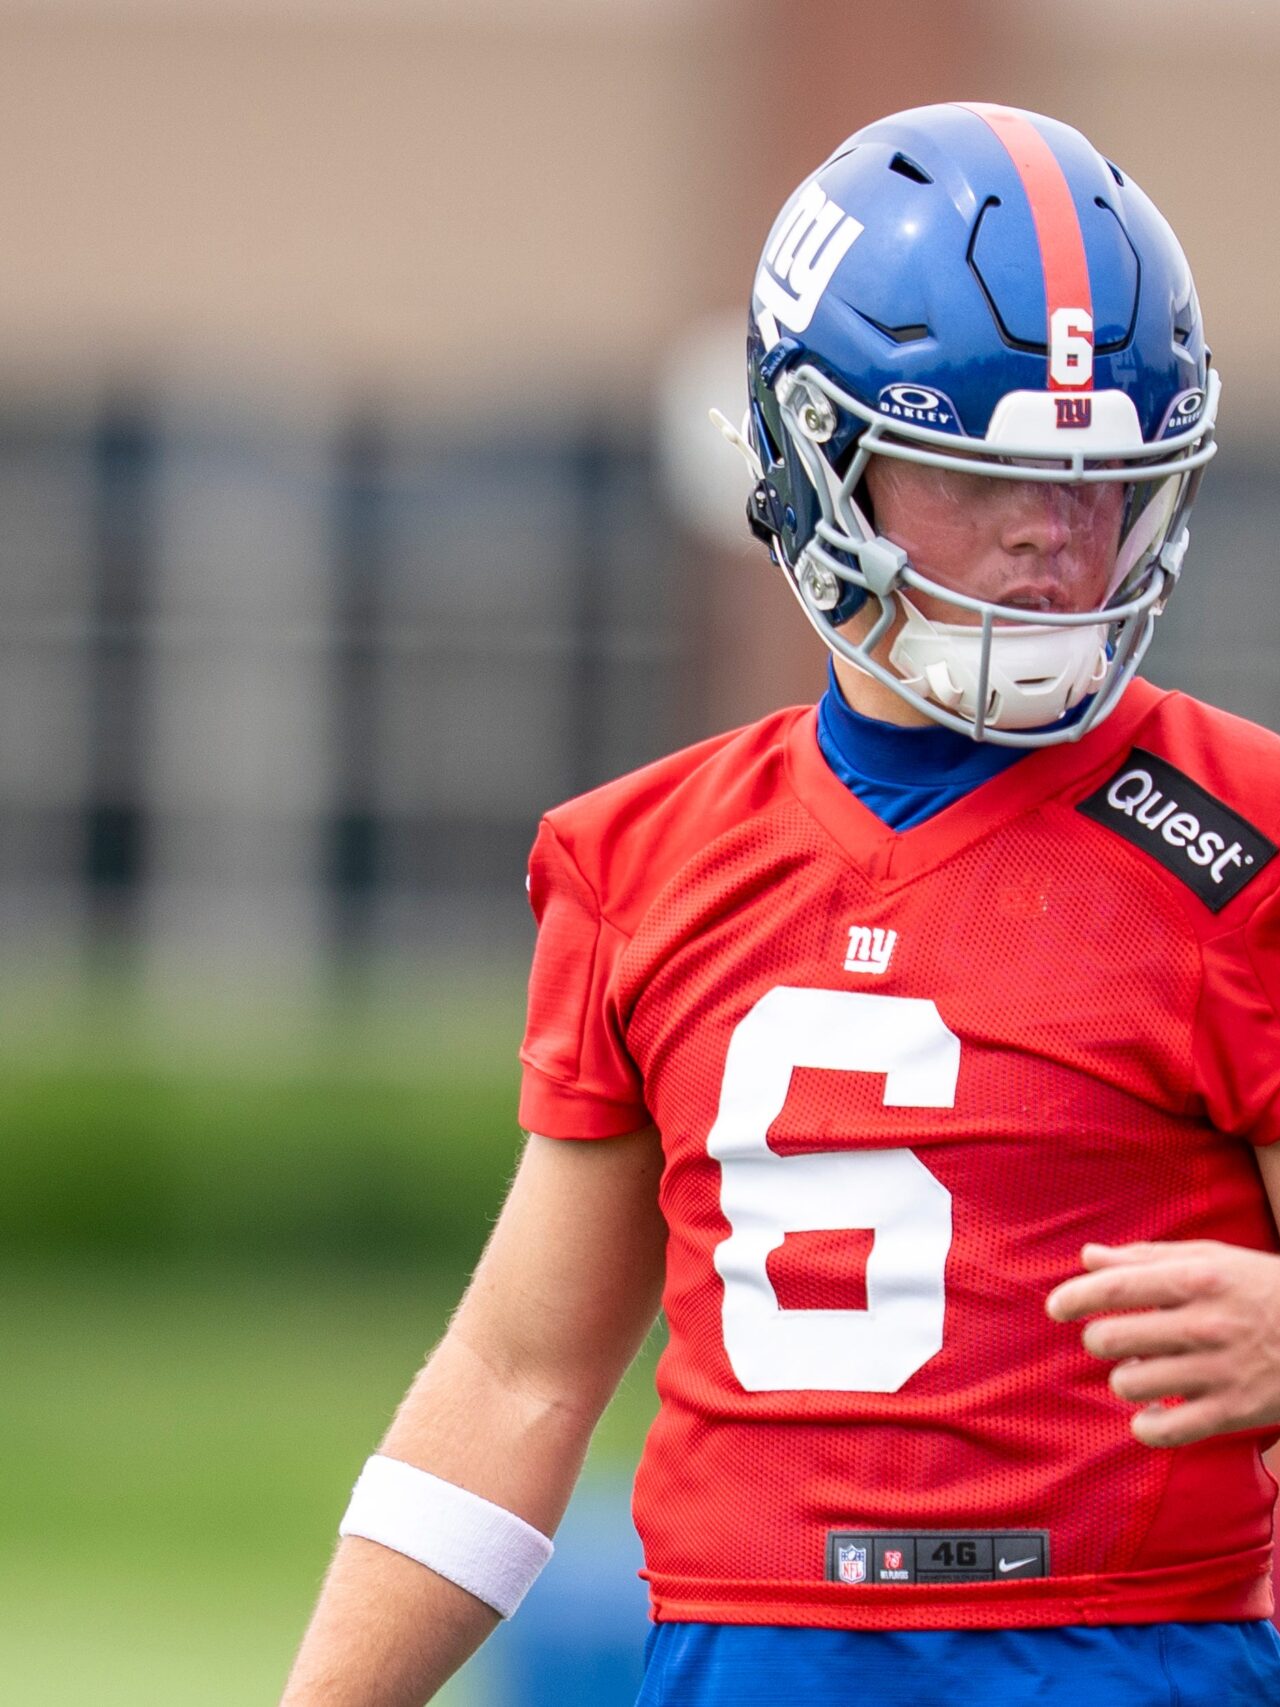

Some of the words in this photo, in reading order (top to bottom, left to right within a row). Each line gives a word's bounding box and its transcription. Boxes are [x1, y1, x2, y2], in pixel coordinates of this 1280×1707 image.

[1049, 308, 1093, 385] 6
[879, 400, 950, 424] OAKLEY
[1106, 768, 1246, 885] Quest
[706, 985, 961, 1393] 6
